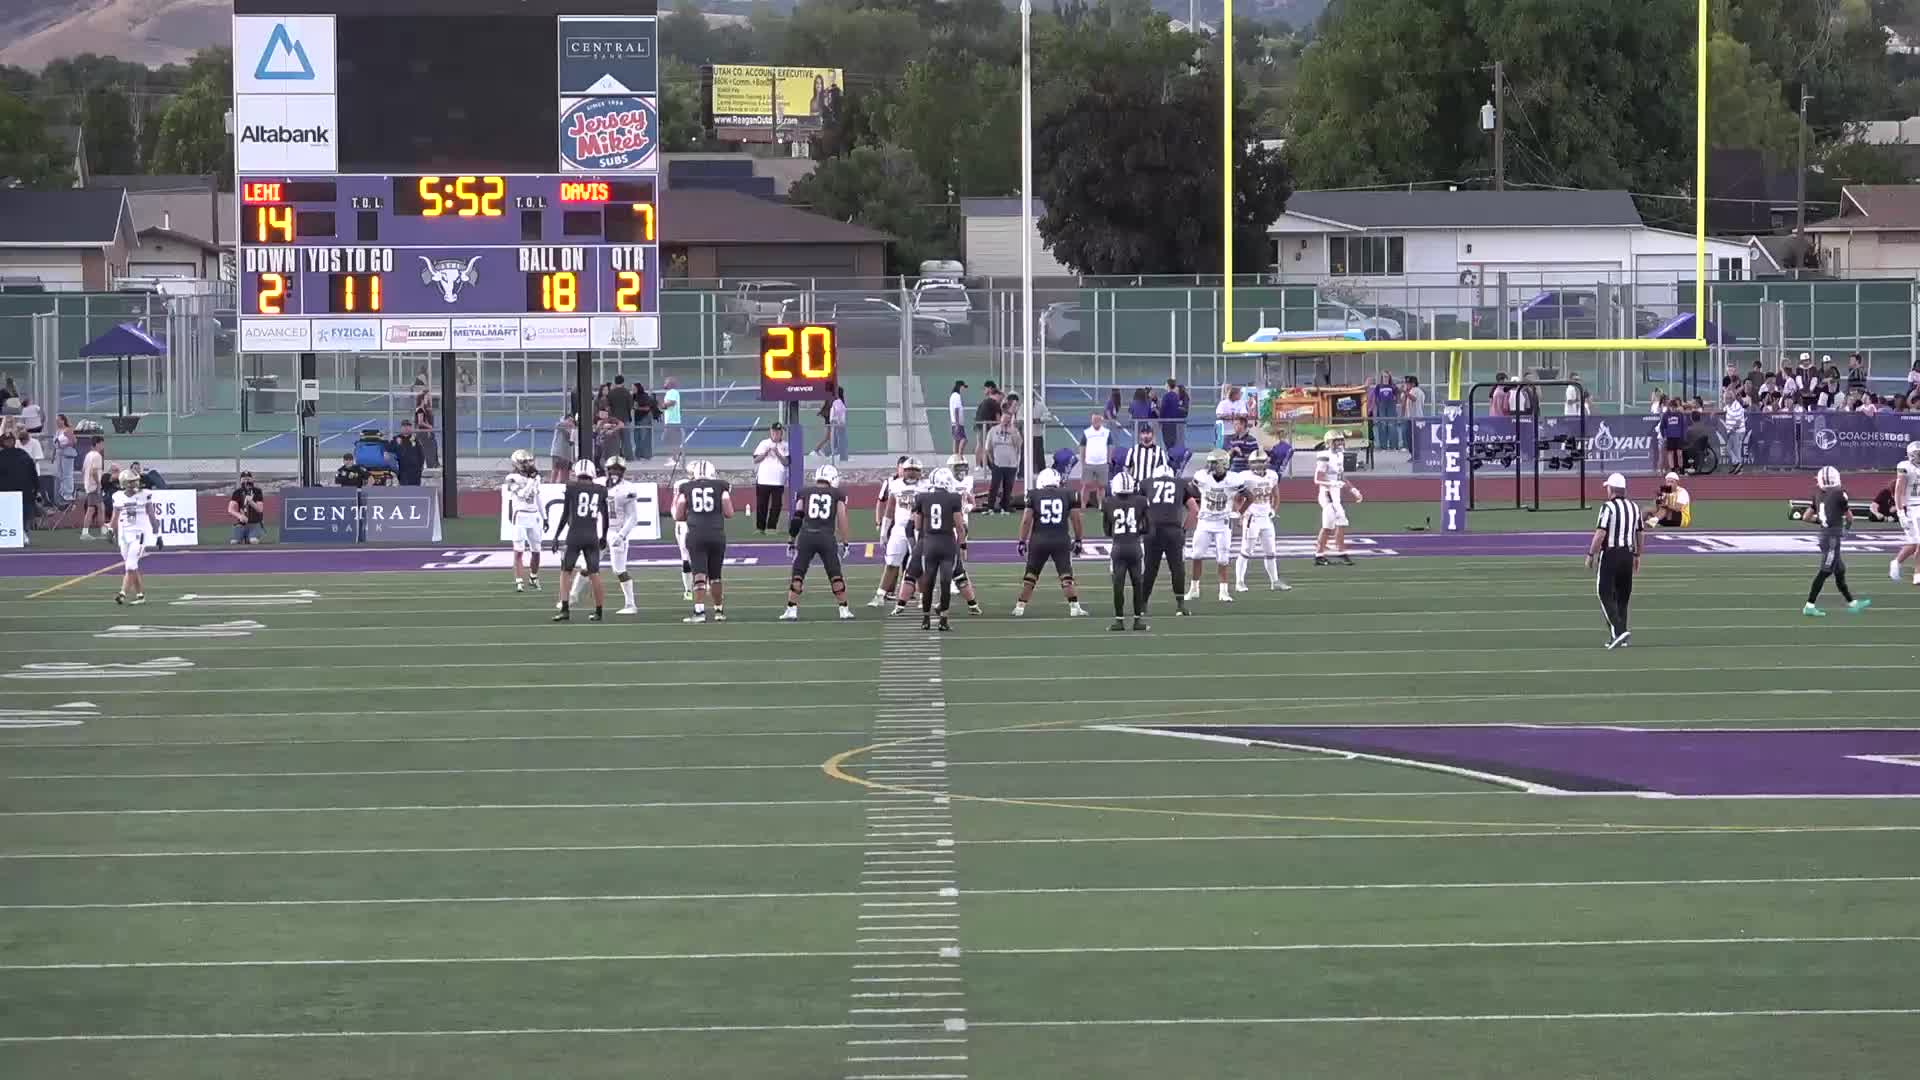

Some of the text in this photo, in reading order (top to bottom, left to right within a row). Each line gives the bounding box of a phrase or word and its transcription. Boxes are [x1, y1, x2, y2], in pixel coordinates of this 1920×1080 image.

[571, 42, 644, 53] CENTRAL
[778, 70, 814, 79] EXECUTIVE
[568, 109, 647, 137] Jersey
[714, 116, 798, 126] www.ReaganOutdor.com
[240, 125, 329, 143] Altabank
[577, 127, 649, 160] Mike's
[599, 154, 629, 168] SUBS
[243, 183, 281, 202] LEHI
[419, 176, 505, 217] 5:52
[560, 182, 609, 202] DAVIS
[257, 206, 294, 242] 14
[632, 203, 654, 241] 7
[246, 249, 296, 272] DOWN
[308, 249, 393, 272] YDS TO GO
[519, 248, 584, 271] BALL ON
[612, 248, 645, 271] QTR
[258, 273, 283, 314] 2
[345, 275, 379, 311] 11
[542, 271, 577, 312] 18
[616, 271, 641, 312] 2
[244, 327, 308, 338] ADVANCED
[331, 327, 375, 338] FYZICAL
[453, 328, 518, 337] METALMART
[764, 326, 832, 379] 20
[691, 487, 715, 513] 66
[1152, 481, 1176, 504] 72
[166, 503, 176, 516] IS
[293, 505, 421, 522] CENTRAL
[577, 492, 600, 518] 84
[808, 493, 832, 519] 63
[930, 503, 943, 530] 8
[1040, 499, 1064, 524] 59
[160, 518, 196, 534] LACE
[332, 524, 383, 533] BAK
[1113, 507, 1137, 534] 24
